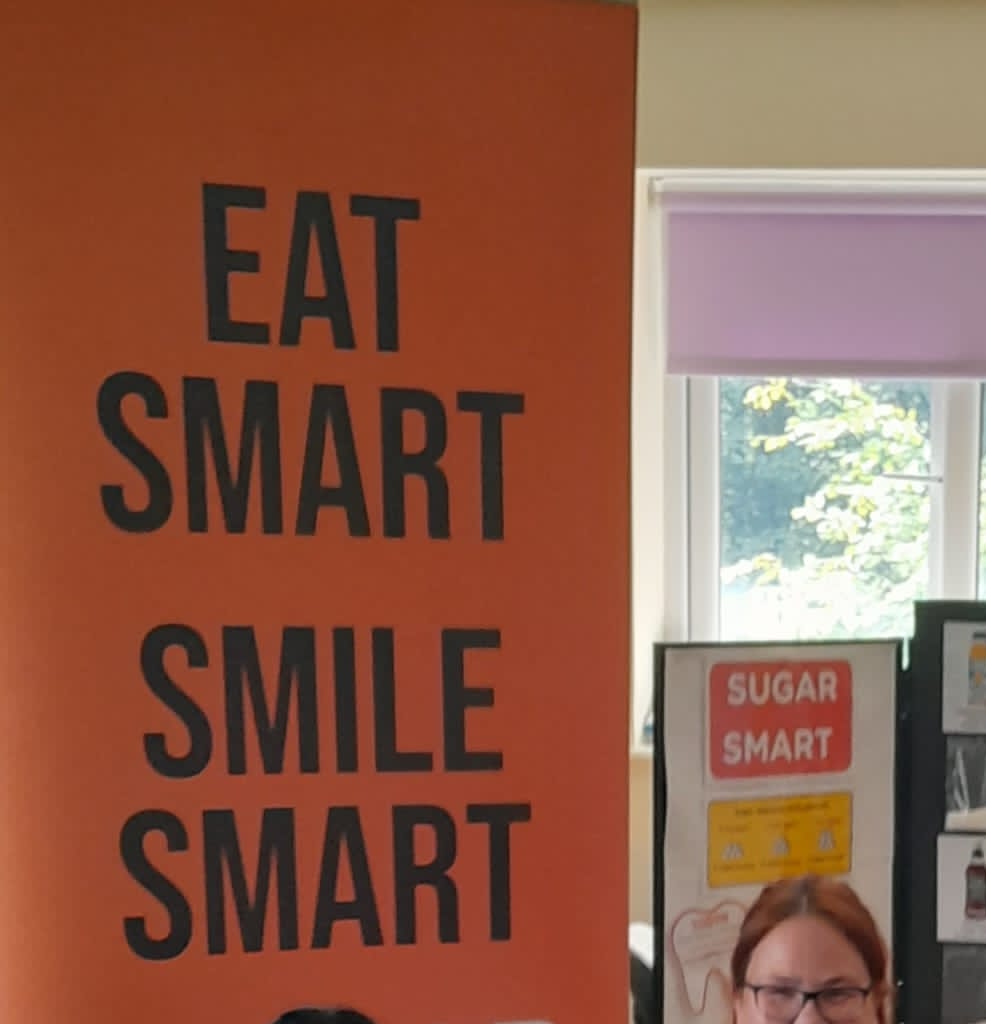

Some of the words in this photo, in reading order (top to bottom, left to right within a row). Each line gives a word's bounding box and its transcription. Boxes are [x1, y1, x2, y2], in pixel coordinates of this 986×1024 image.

[202, 182, 421, 353] EAT
[95, 370, 525, 541] SMART
[139, 622, 504, 779] SMILE
[722, 726, 833, 765] SMART
[727, 669, 838, 706] SUGAR
[118, 803, 532, 961] SMART
